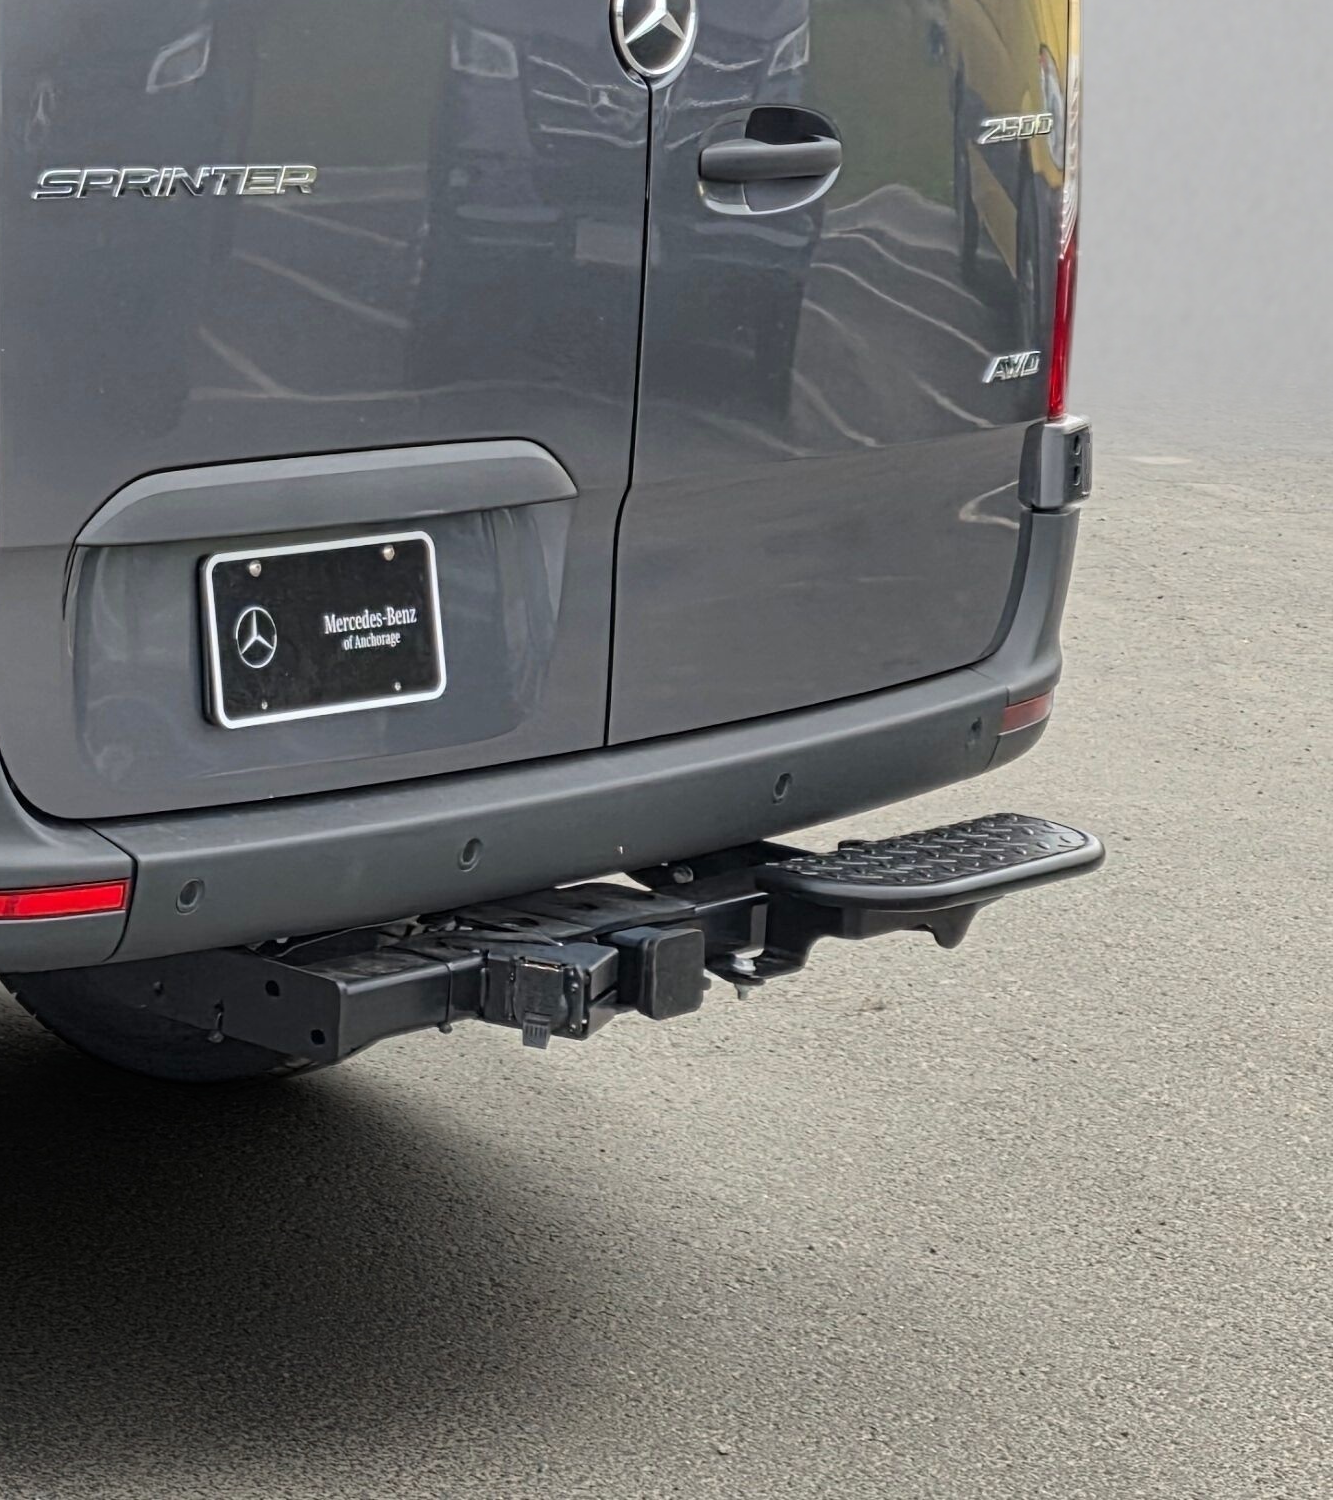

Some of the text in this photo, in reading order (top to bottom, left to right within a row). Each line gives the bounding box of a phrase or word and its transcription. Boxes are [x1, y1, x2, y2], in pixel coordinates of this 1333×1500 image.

[976, 111, 1054, 146] 2500
[31, 164, 319, 201] SPRINTER
[982, 350, 1042, 384] AWD
[323, 606, 418, 635] Mercedes-Benz
[342, 631, 401, 651] of Anchorage
